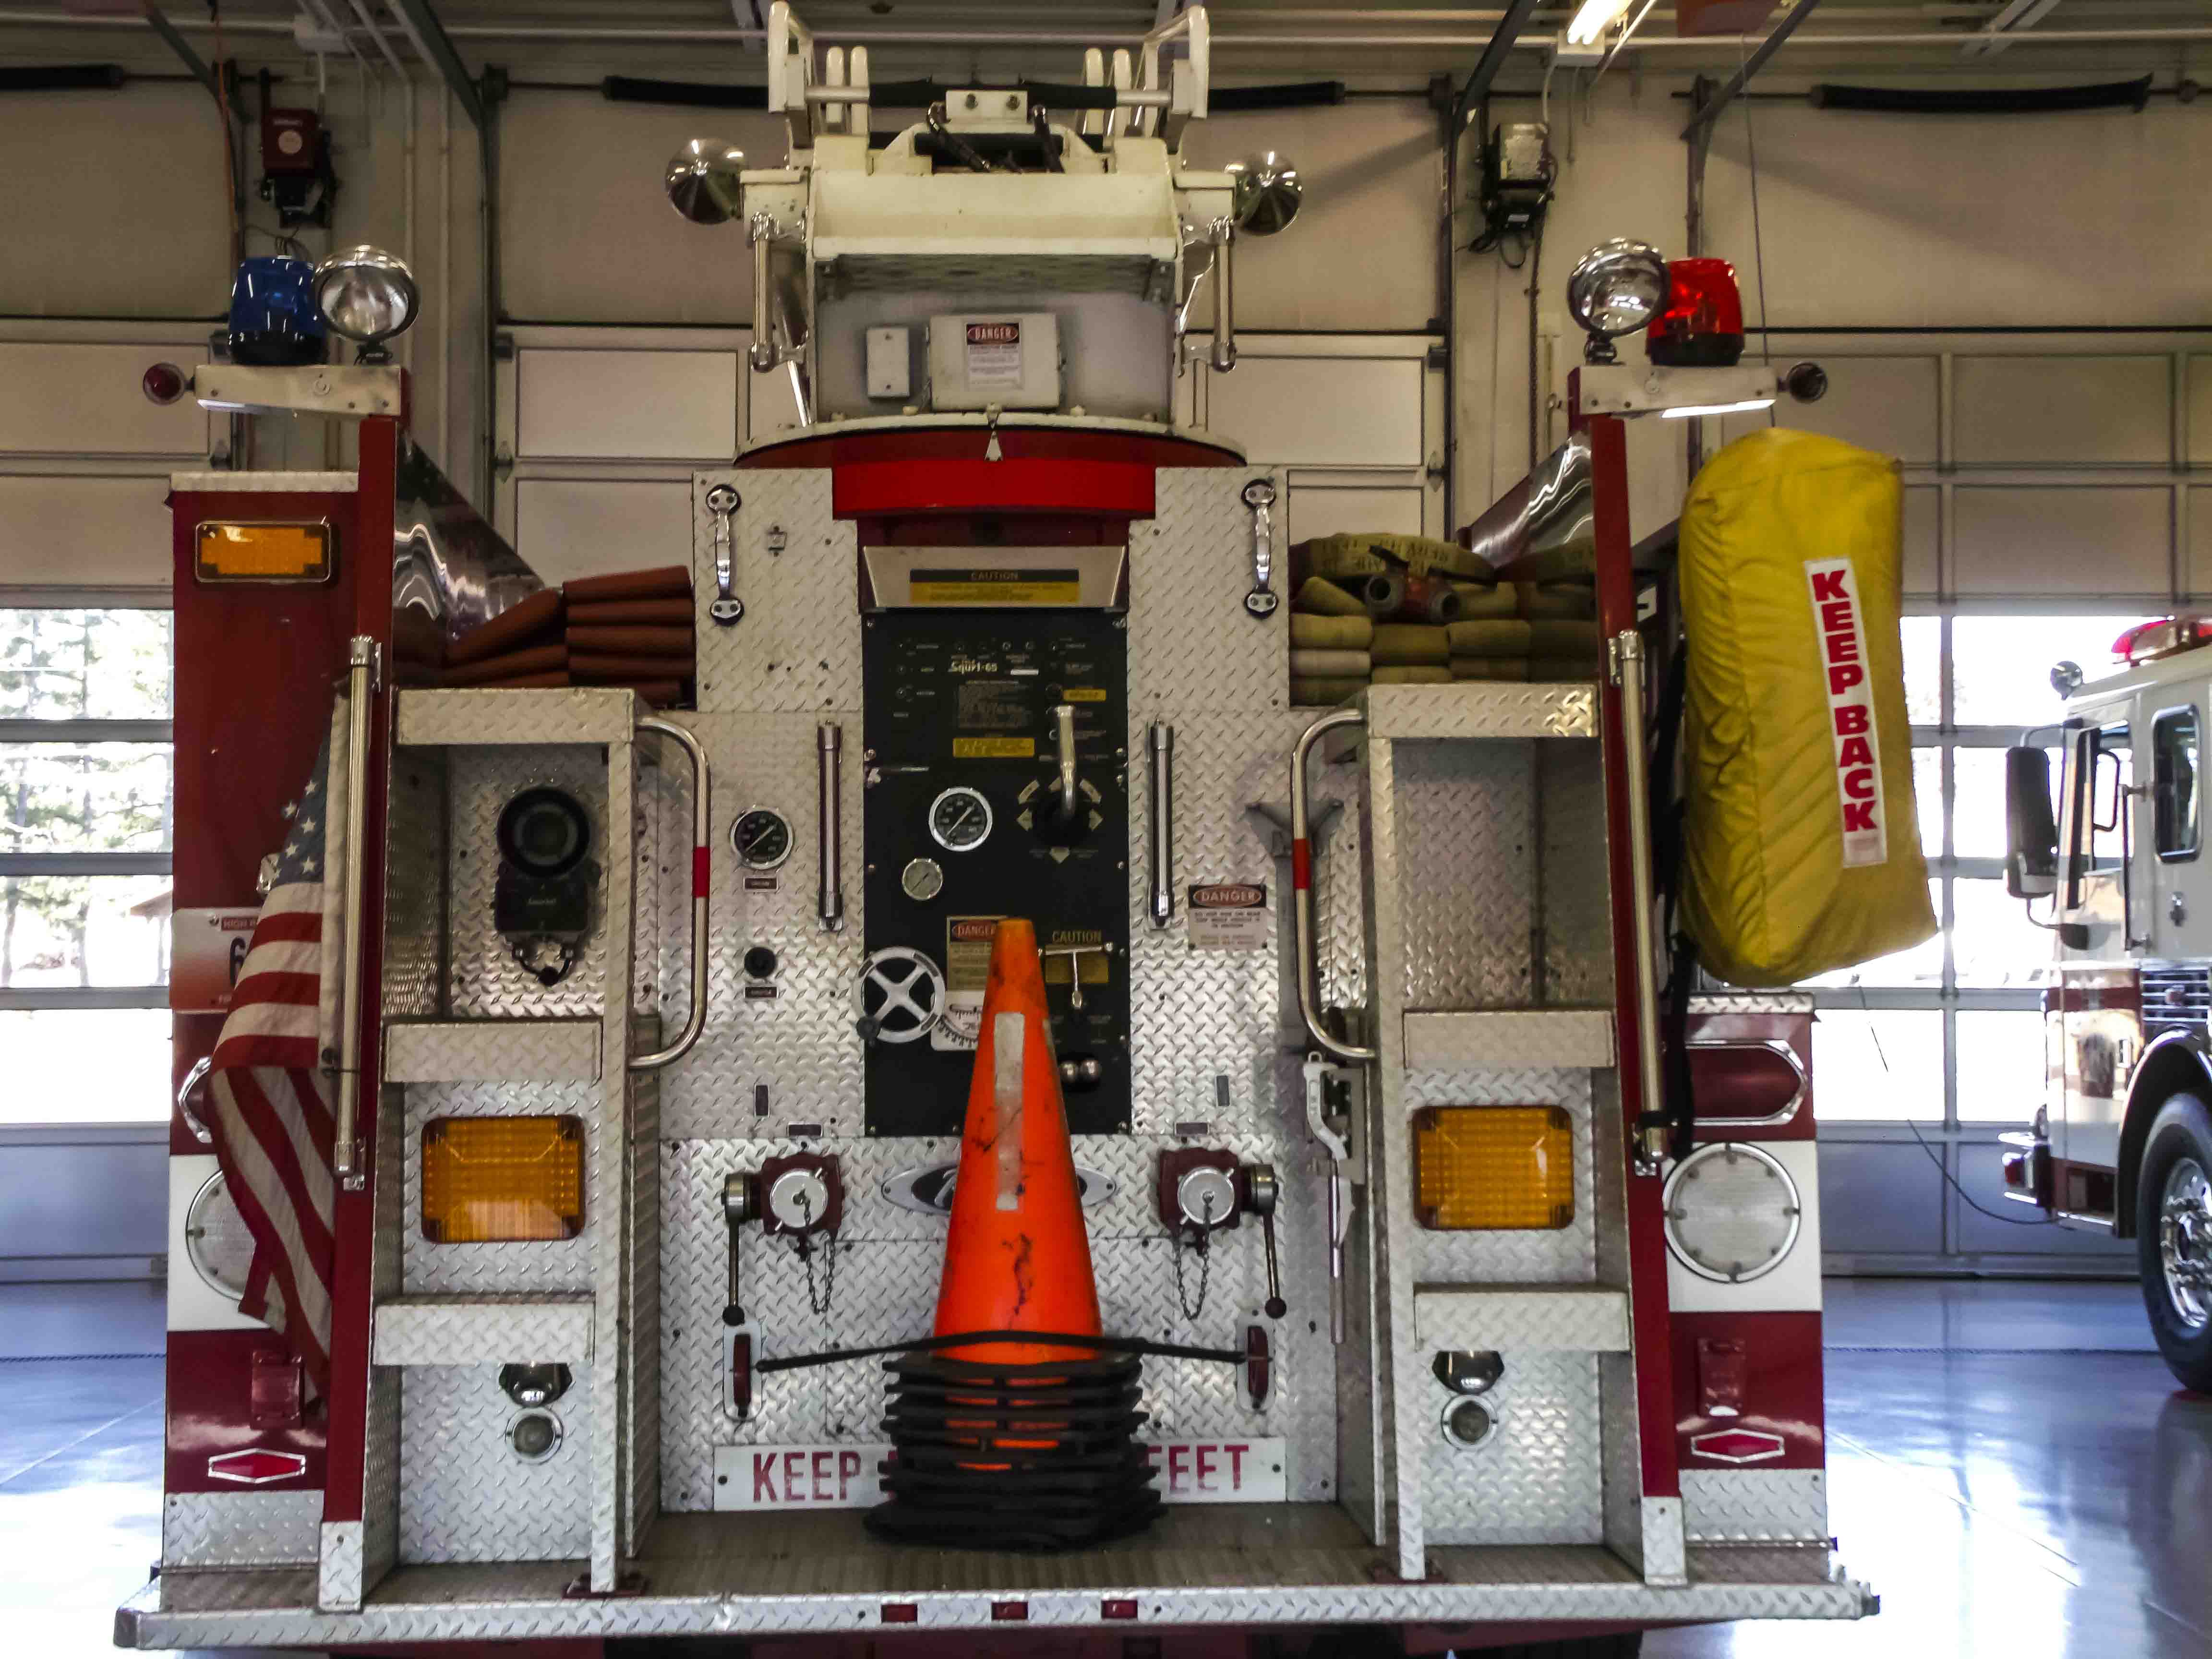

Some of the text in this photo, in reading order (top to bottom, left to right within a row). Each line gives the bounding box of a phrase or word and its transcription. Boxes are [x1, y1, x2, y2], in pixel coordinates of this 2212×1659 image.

[975, 327, 1011, 340] DANGER
[971, 572, 1018, 580] CAUTION
[1812, 569, 1864, 695] KEEP
[1834, 705, 1877, 832] BACK
[1202, 890, 1256, 902] DANGER
[1052, 930, 1102, 943] CAUTION
[753, 1451, 861, 1502] KEEP
